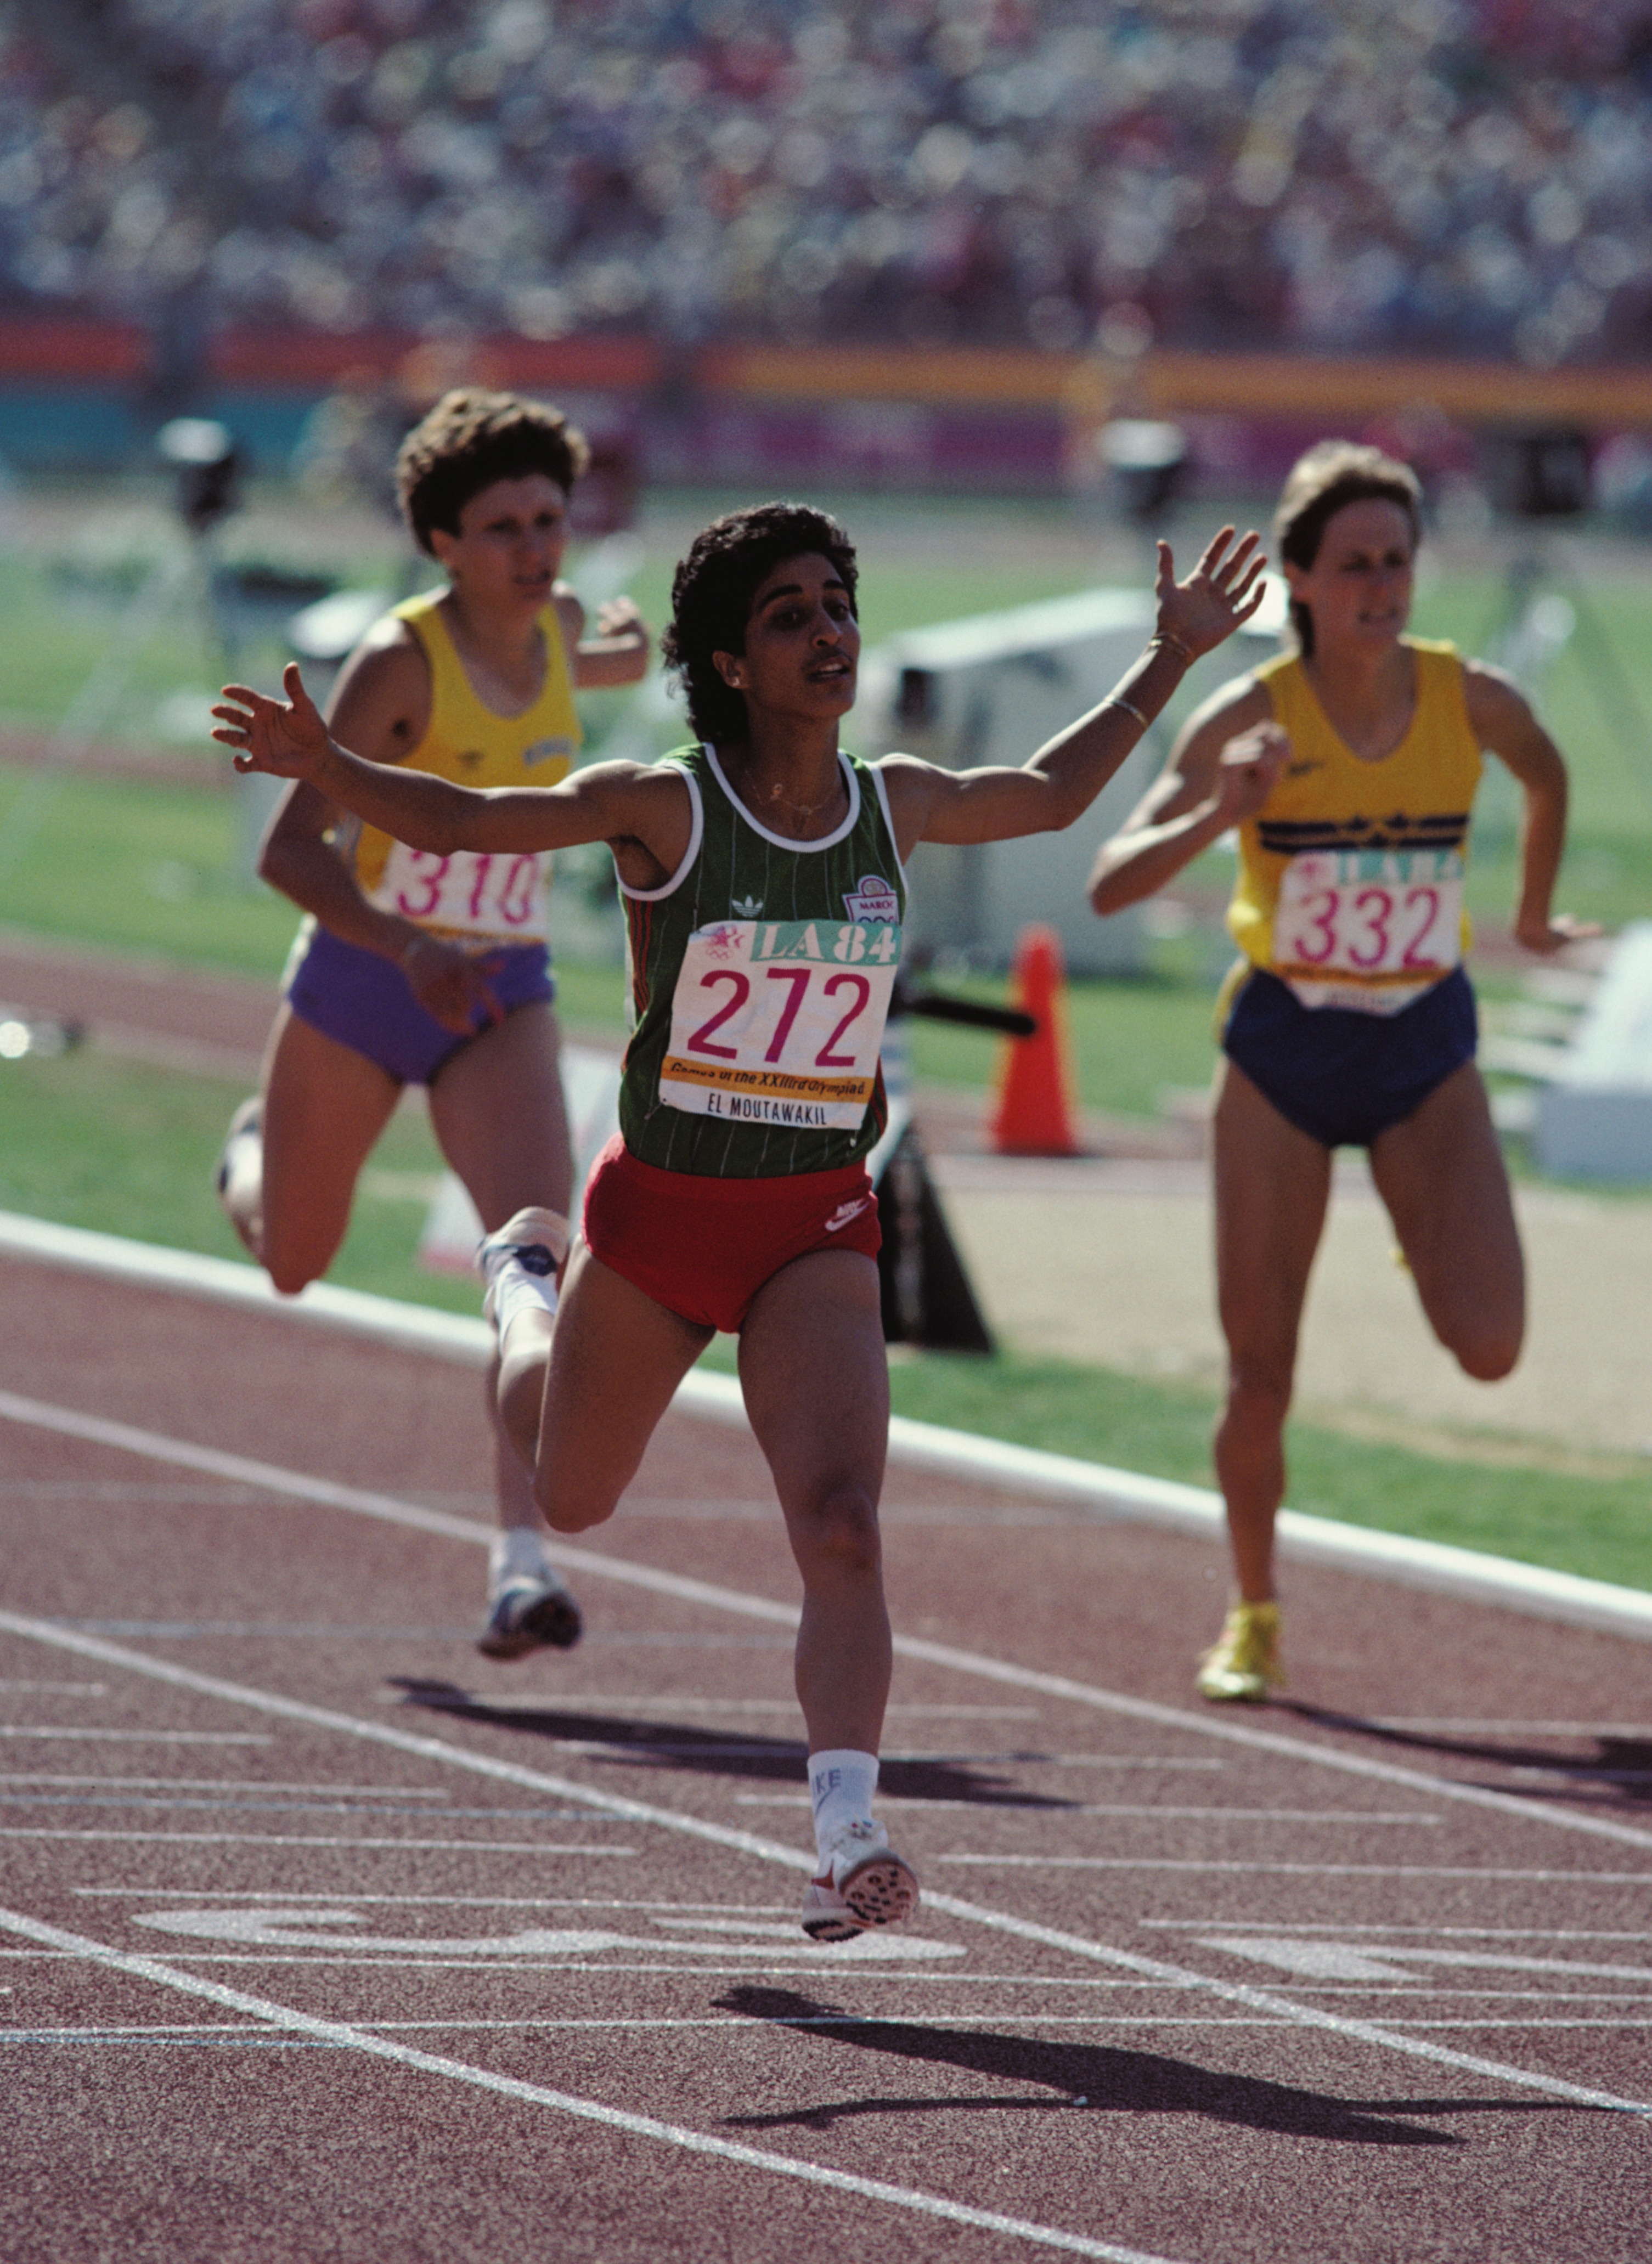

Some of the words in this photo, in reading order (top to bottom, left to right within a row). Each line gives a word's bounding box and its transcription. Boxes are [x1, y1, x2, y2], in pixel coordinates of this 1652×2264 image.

[759, 922, 823, 958] LA
[833, 924, 897, 963] 84
[1294, 887, 1439, 971] 332
[687, 967, 871, 1067] 272
[735, 1072, 757, 1084] the
[708, 1093, 721, 1114] EL
[730, 1097, 826, 1125] MOUTAWAKIL
